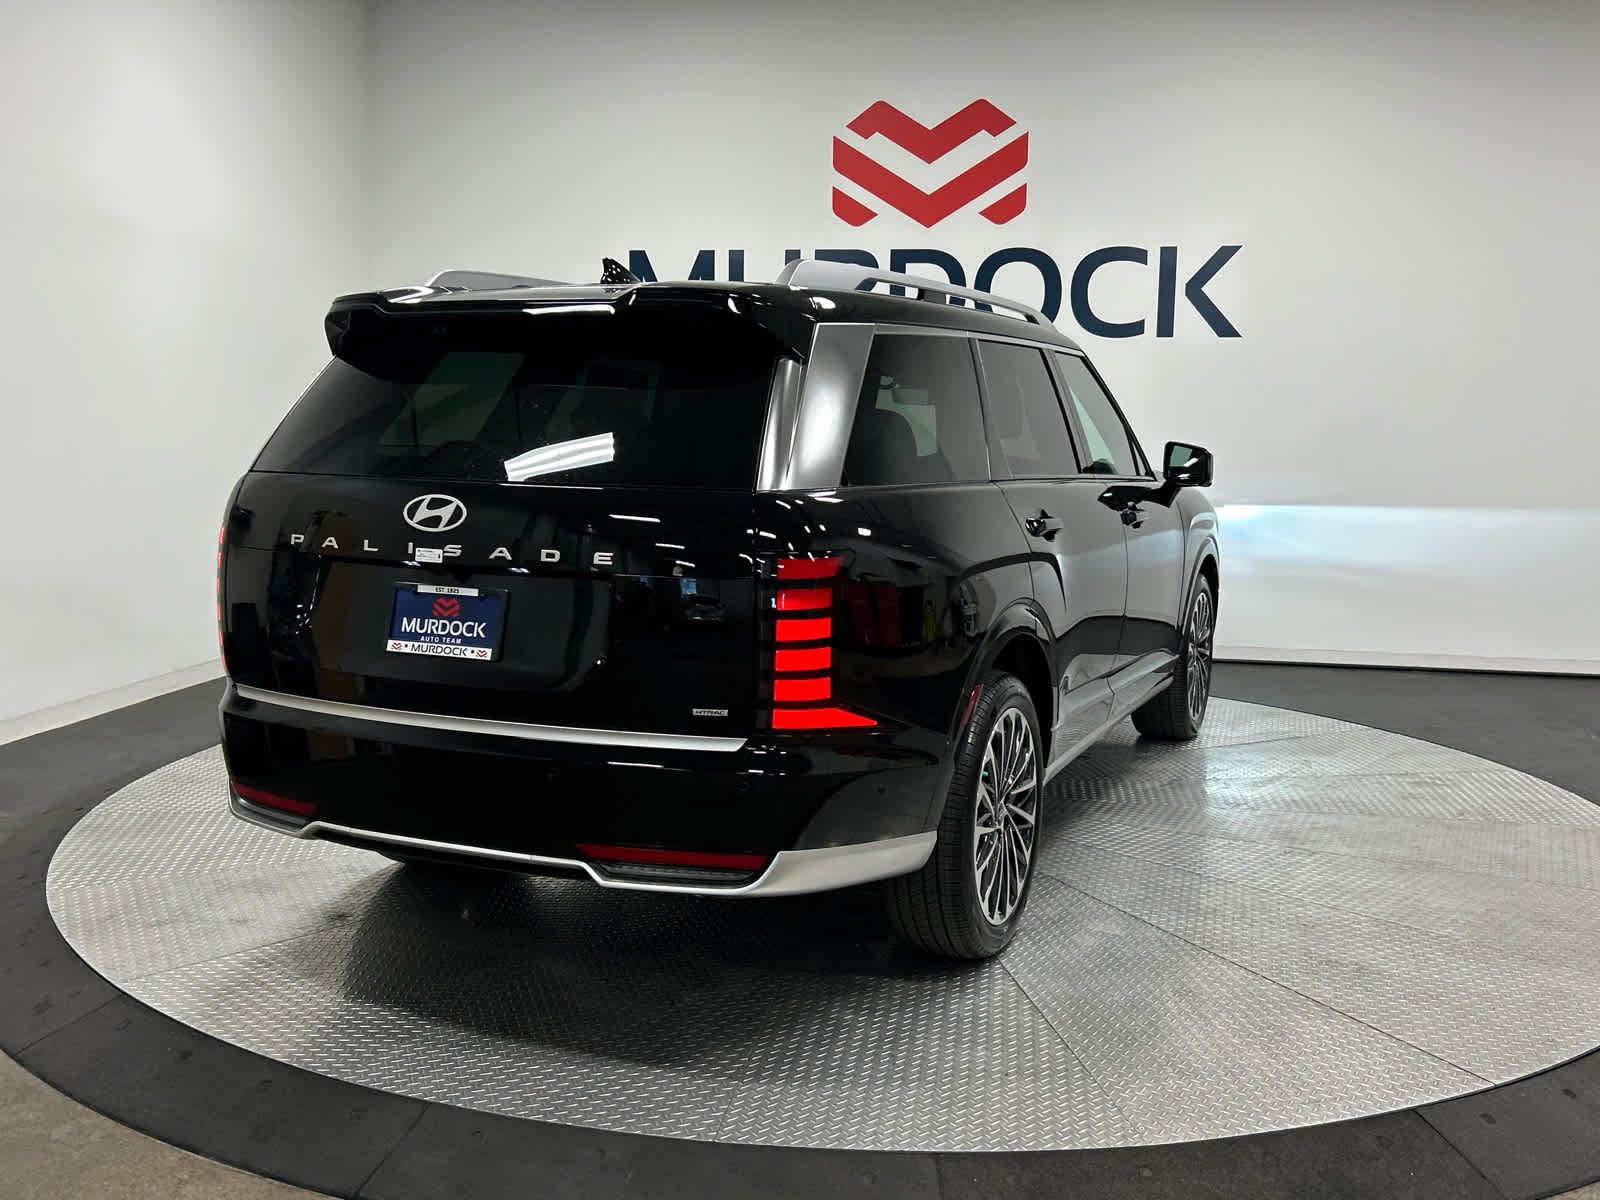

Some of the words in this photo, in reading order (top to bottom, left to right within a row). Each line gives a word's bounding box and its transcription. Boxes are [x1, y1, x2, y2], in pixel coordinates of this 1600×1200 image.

[290, 533, 614, 565] PALISADE
[401, 617, 487, 638] MURDOCK
[420, 635, 440, 643] AUTO
[411, 643, 467, 656] MURDOCK
